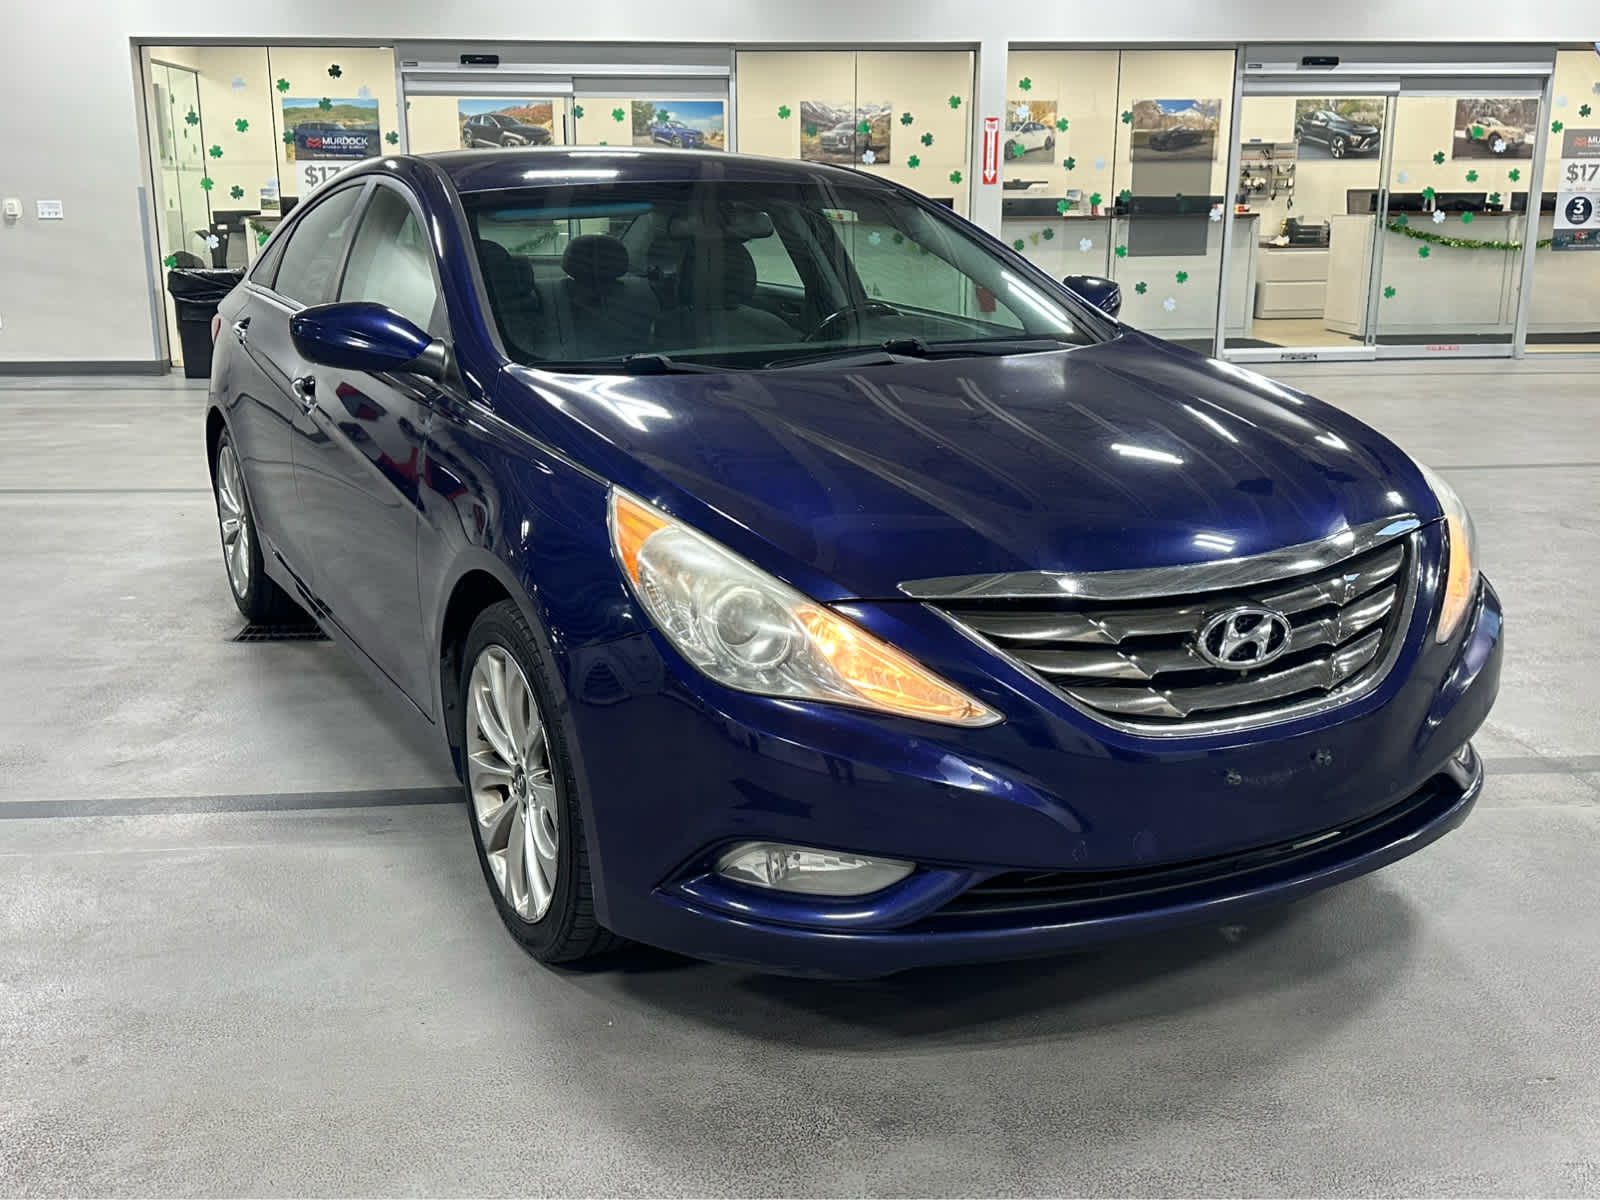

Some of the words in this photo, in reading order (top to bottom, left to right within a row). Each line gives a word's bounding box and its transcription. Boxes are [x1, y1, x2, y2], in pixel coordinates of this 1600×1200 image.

[322, 136, 368, 145] MURDOCK
[304, 164, 347, 187] $17
[1573, 198, 1585, 215] 3
